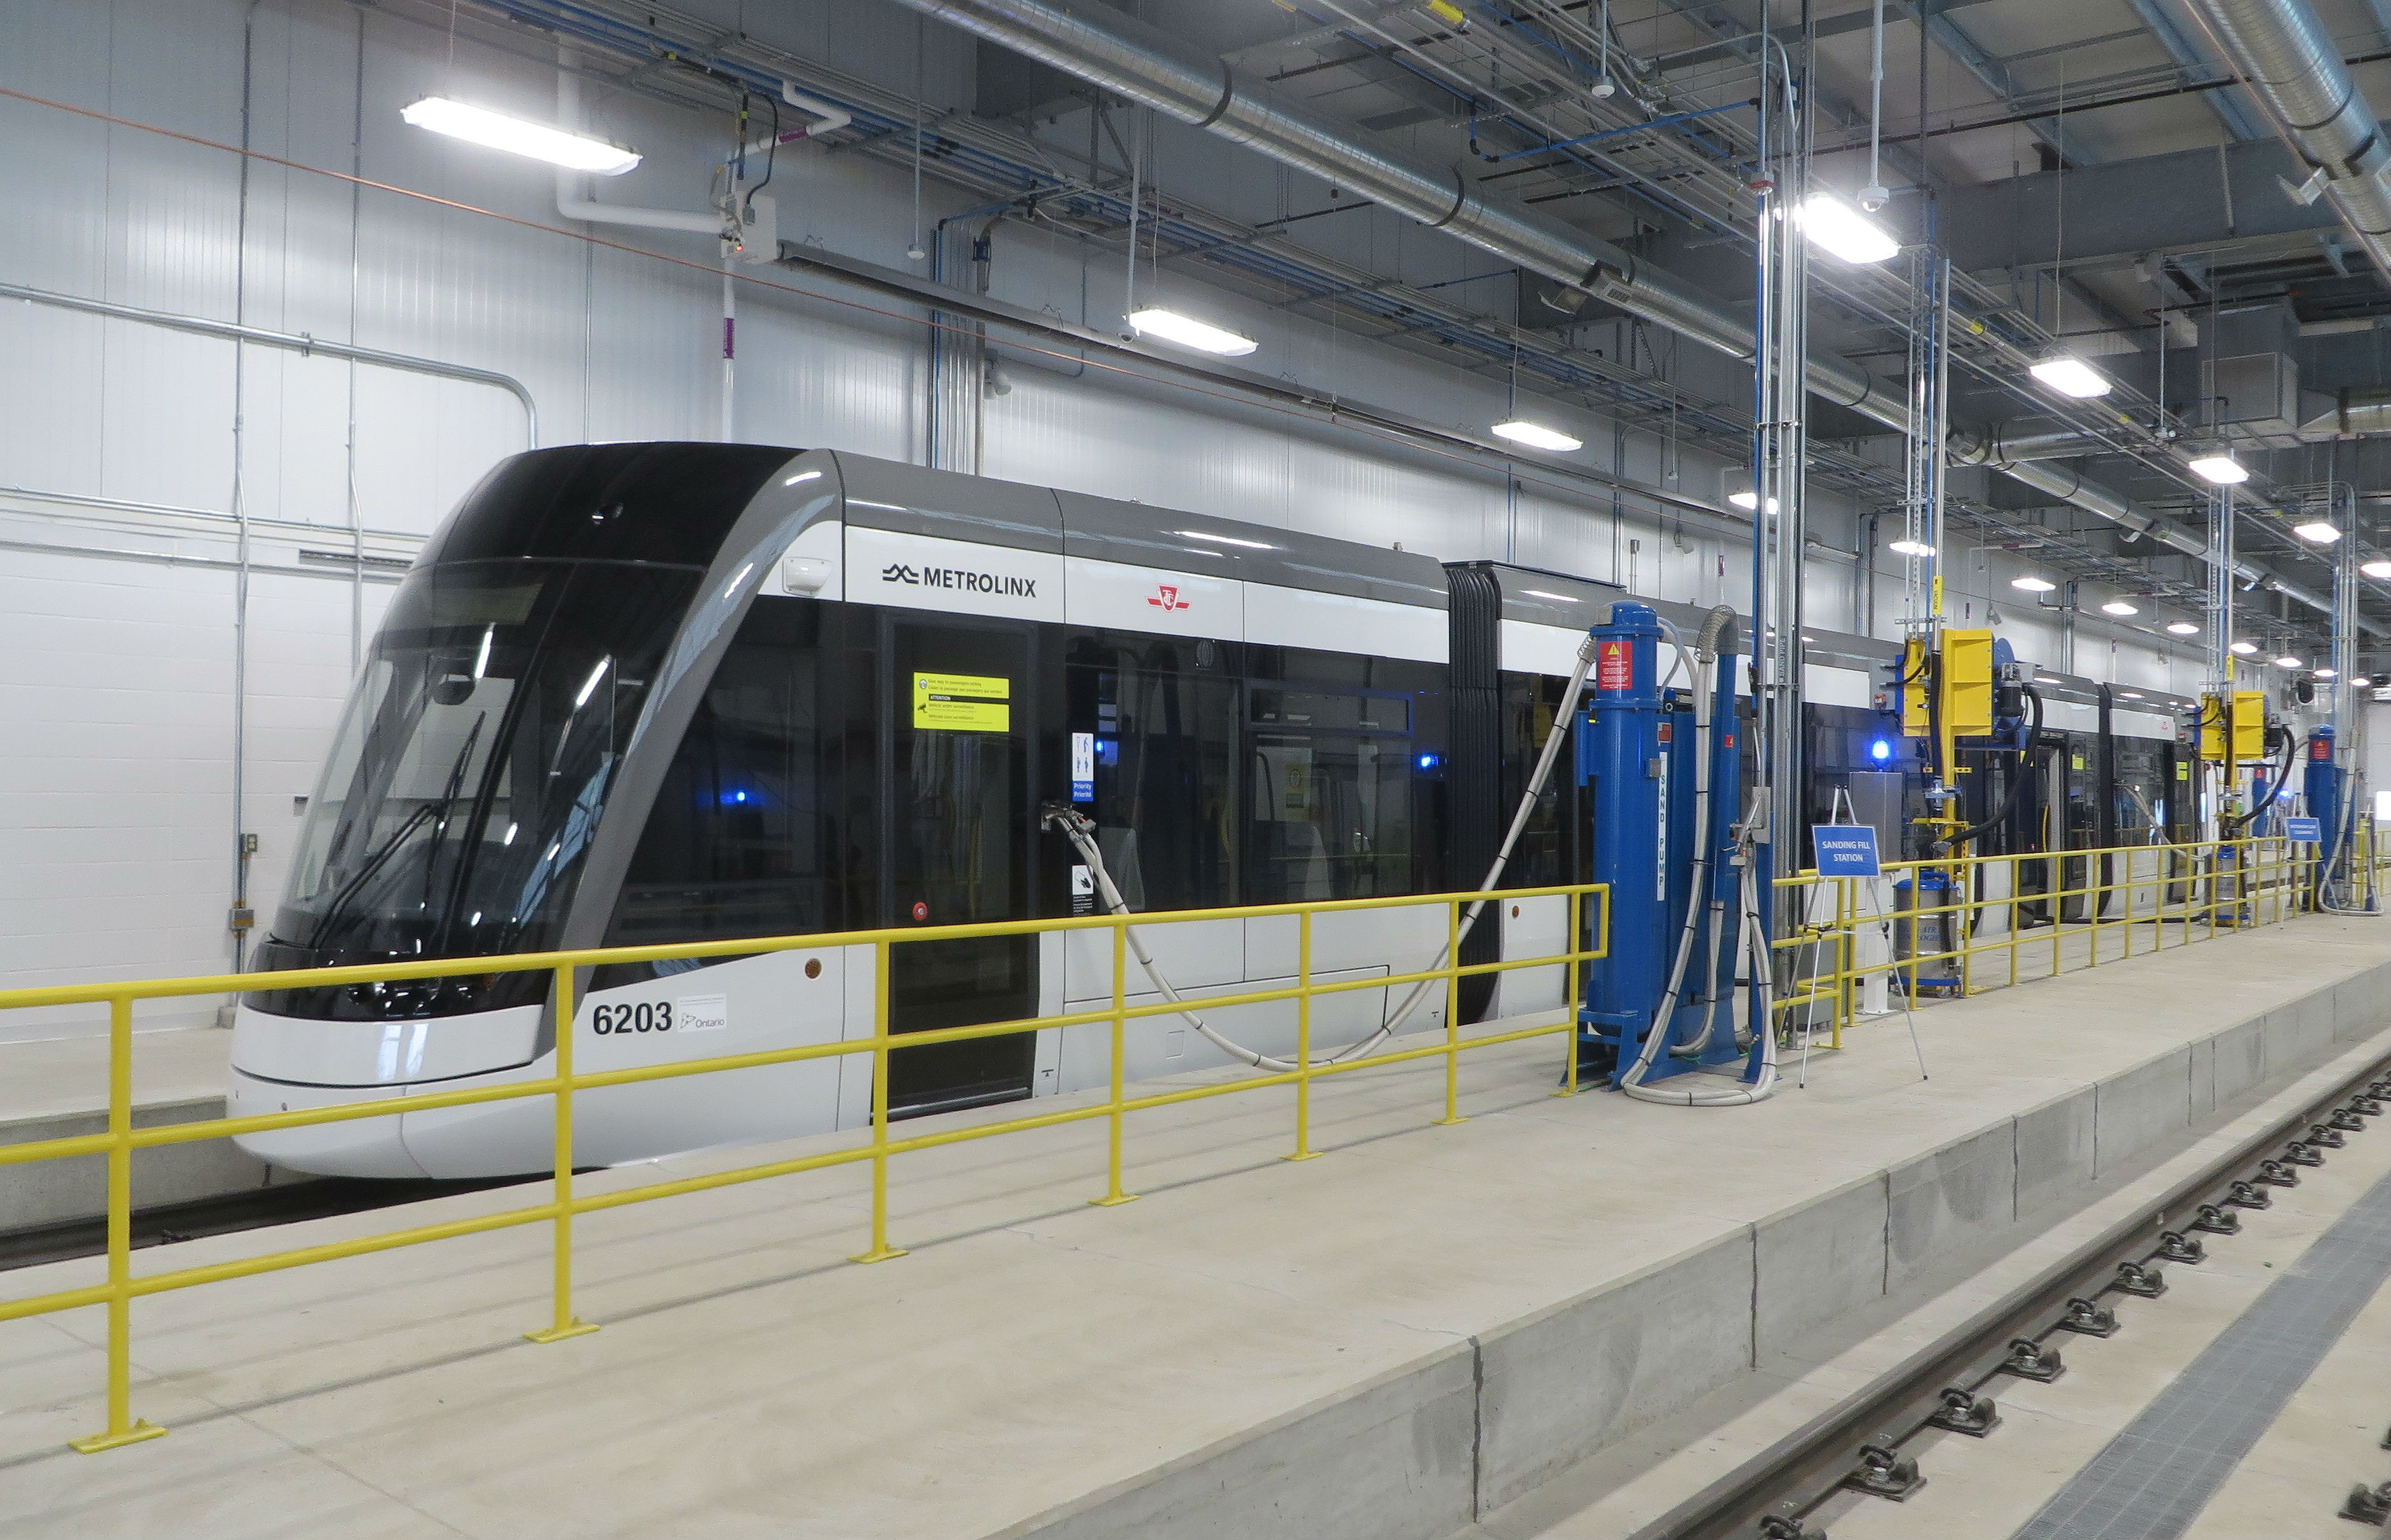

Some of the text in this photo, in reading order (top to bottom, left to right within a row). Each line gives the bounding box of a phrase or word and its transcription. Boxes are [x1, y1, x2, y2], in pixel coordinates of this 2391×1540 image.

[923, 566, 1038, 598] METROLINX
[1074, 782, 1092, 791] Priority
[1822, 841, 1871, 850] SANDING FILL
[1833, 854, 1863, 862] STATION
[593, 1001, 673, 1035] 6203
[695, 1018, 725, 1028] Ontario
